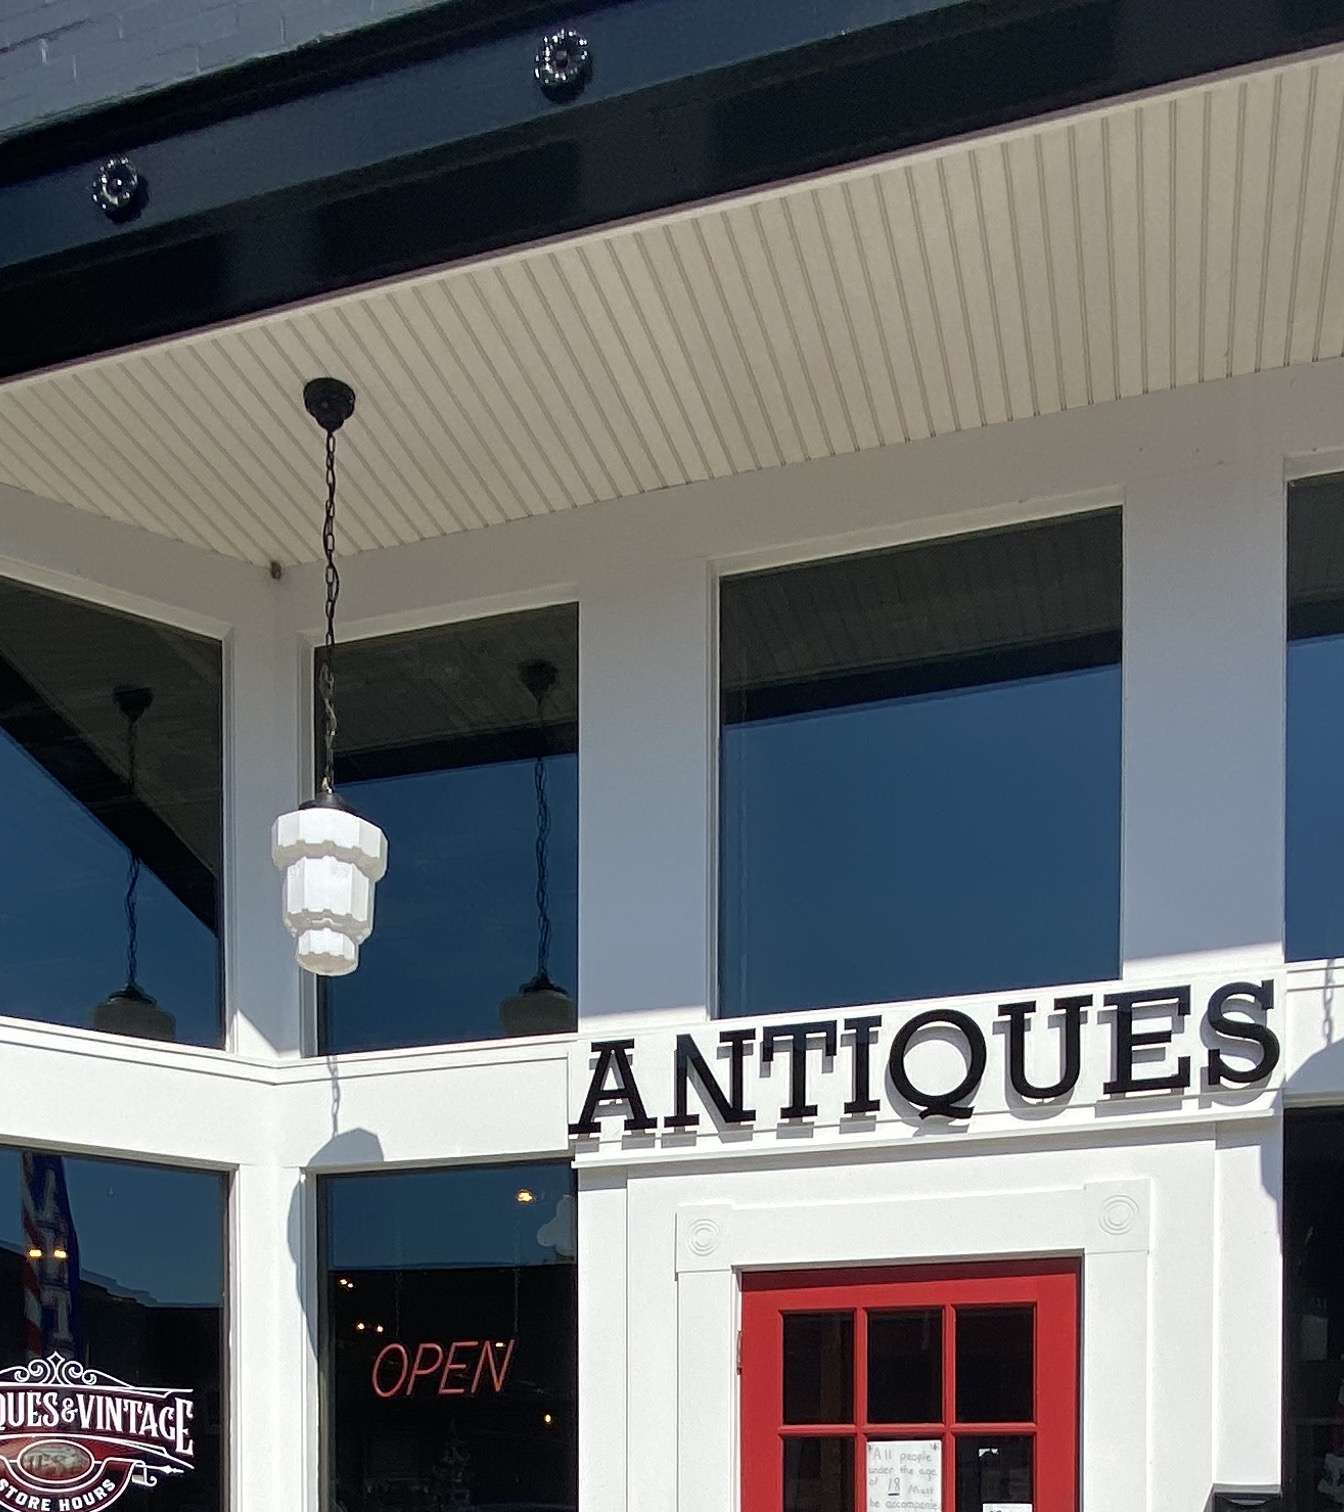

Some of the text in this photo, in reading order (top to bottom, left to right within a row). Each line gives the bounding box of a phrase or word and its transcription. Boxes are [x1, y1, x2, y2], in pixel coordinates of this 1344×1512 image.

[568, 979, 1280, 1135] ANTIQUES
[372, 1338, 516, 1398] OPEN
[58, 1478, 116, 1512] HOURS
